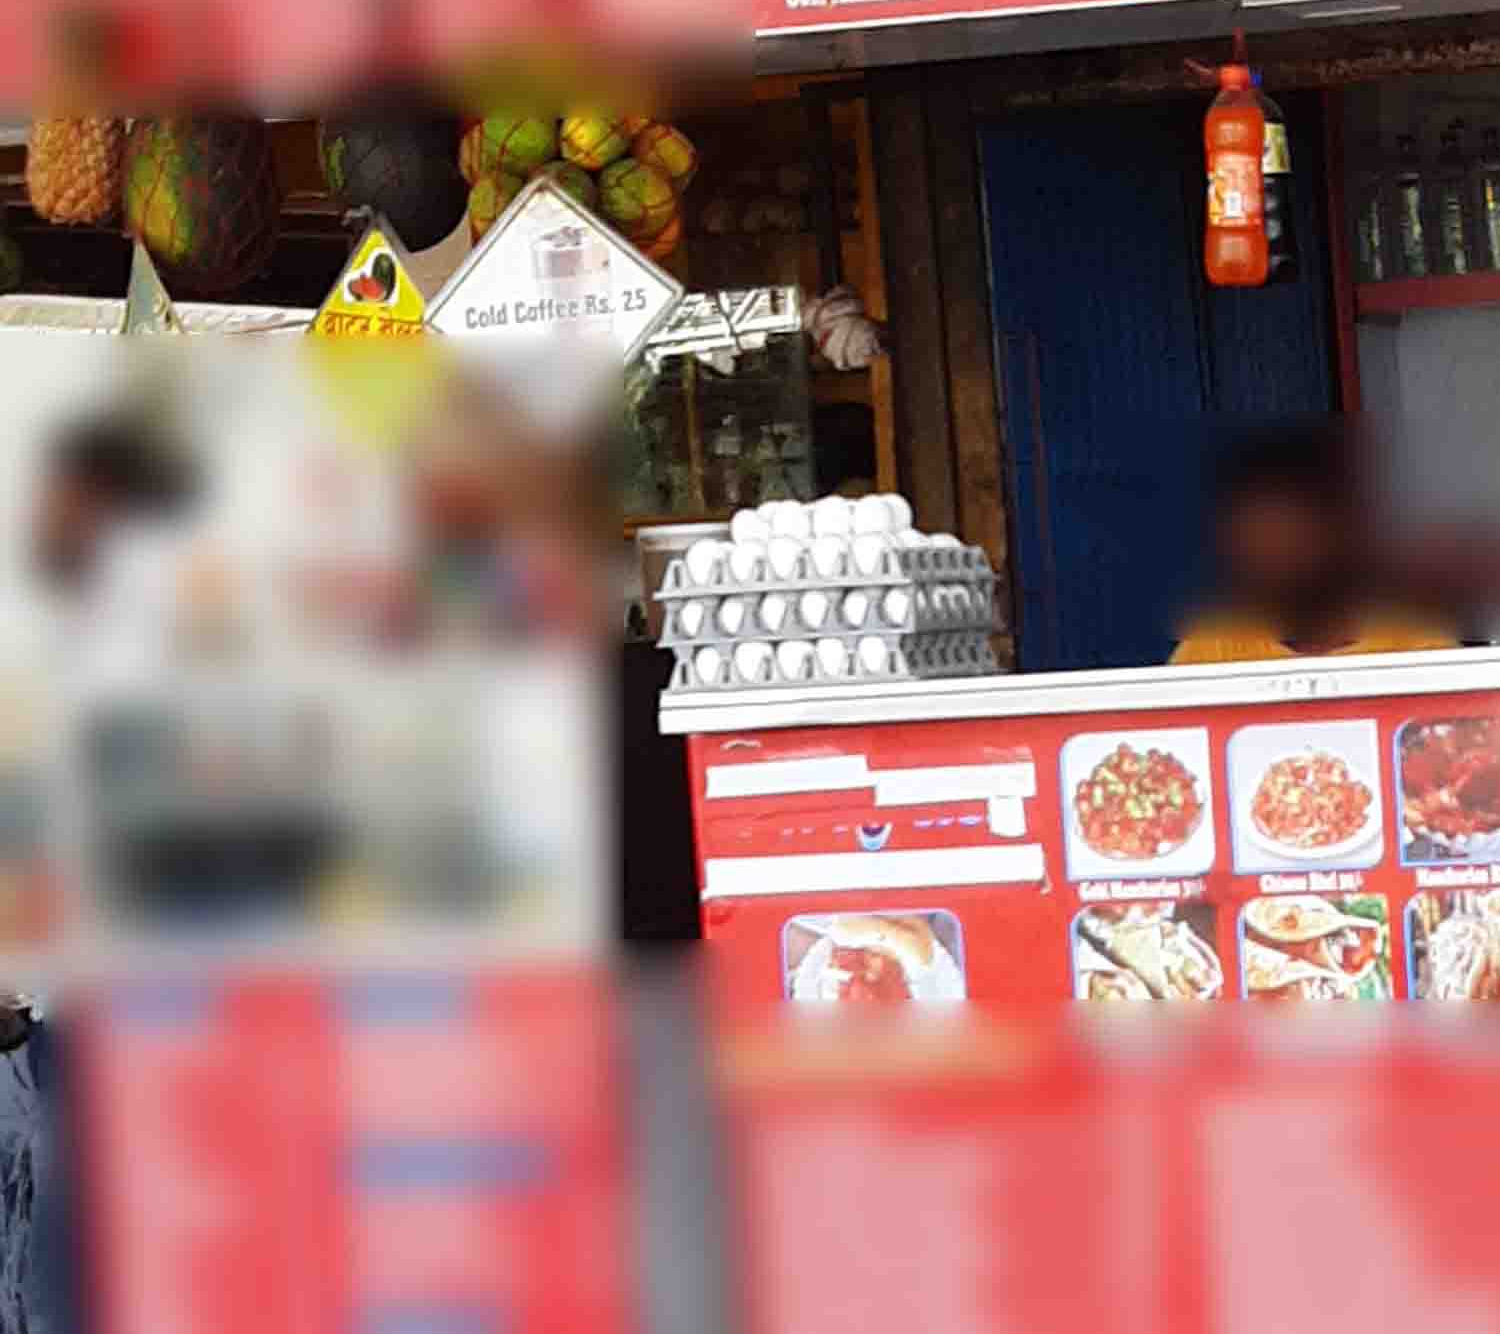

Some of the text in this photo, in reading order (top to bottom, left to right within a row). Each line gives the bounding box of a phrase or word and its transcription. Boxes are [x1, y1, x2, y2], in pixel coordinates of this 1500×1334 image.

[465, 288, 648, 329] Cold Coffee Rs. 25
